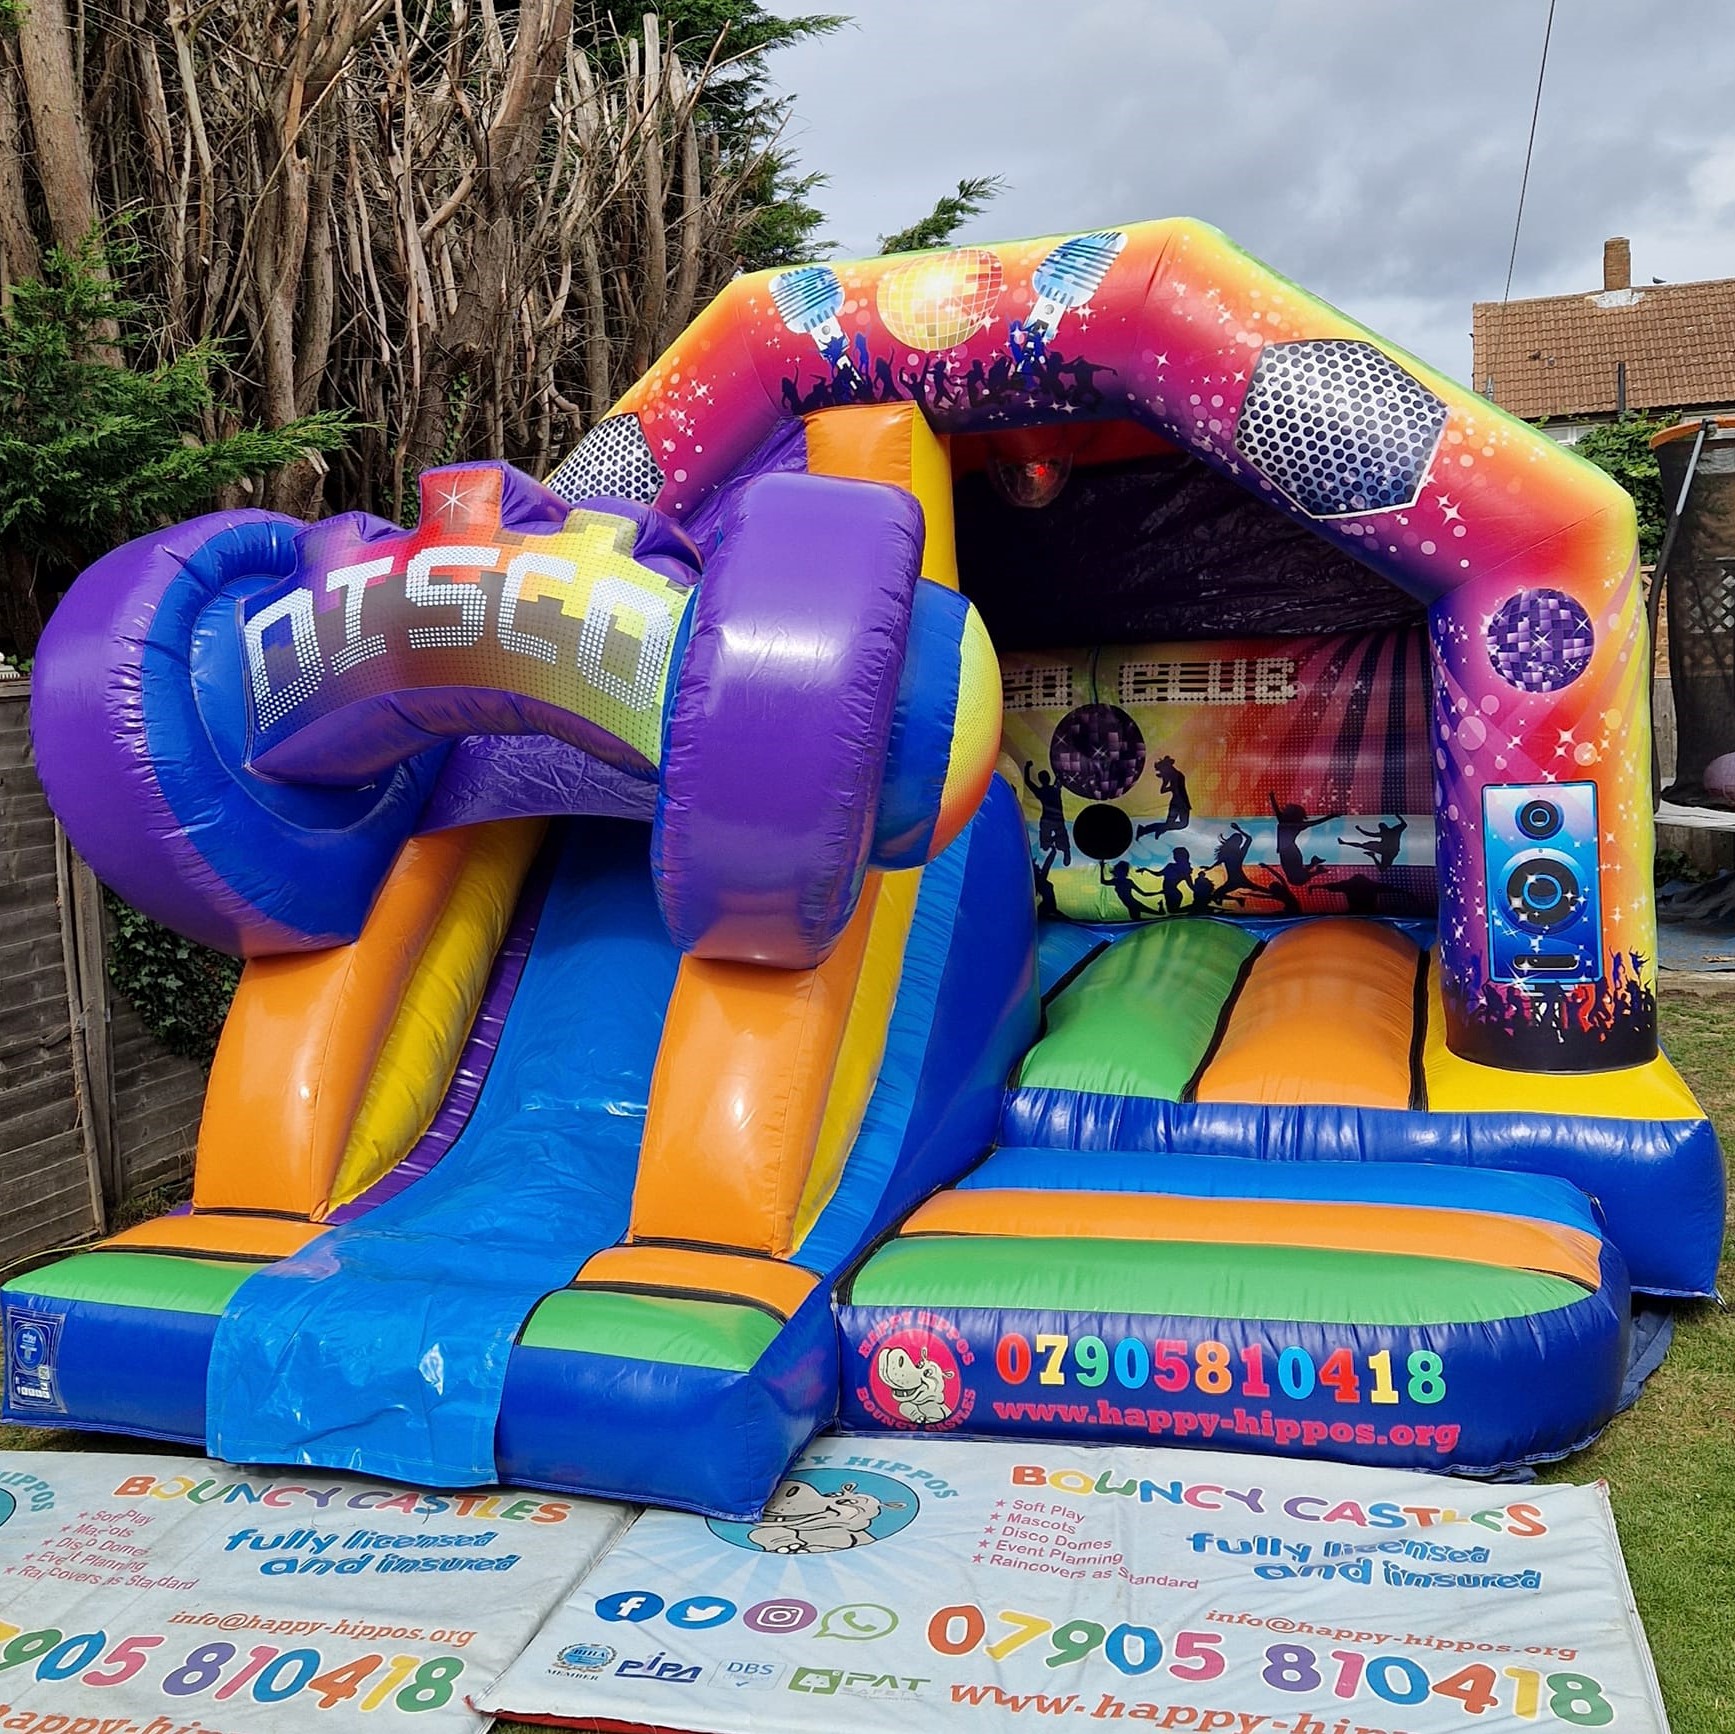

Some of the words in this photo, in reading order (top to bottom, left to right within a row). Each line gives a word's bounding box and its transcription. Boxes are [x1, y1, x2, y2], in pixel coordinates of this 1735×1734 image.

[243, 545, 673, 732] DISCO
[1119, 656, 1297, 705] CLUB
[858, 1311, 913, 1359] HAPPY
[996, 1332, 1447, 1405] 07905810418
[993, 1399, 1462, 1453] www.happy-hippos.org
[844, 1455, 960, 1499] HIPPOS
[1010, 1464, 1265, 1514] BOUNCY
[113, 1475, 343, 1509] BOUNCY
[346, 1490, 571, 1524] CASTLES
[1012, 1499, 1046, 1513] Soft
[1050, 1504, 1086, 1524] Play
[224, 1528, 340, 1556] fully
[342, 1528, 499, 1550] licensed
[1001, 1525, 1050, 1544] Disco
[1054, 1535, 1113, 1551] Domes
[1006, 1512, 1077, 1535] Mascots
[55, 1537, 98, 1550] Diso
[995, 1540, 1045, 1558] Event
[1049, 1550, 1124, 1567] Planning
[1186, 1532, 1313, 1562] fully
[1322, 1538, 1492, 1565] licensed
[259, 1554, 375, 1577] and
[376, 1552, 522, 1574] insured
[989, 1553, 1087, 1580] Raincovers
[1091, 1569, 1113, 1580] as
[1117, 1566, 1200, 1590] Standard
[1252, 1556, 1374, 1587] and
[1382, 1559, 1544, 1590] insured
[167, 1610, 478, 1648] info@happy-hippos.org
[1205, 1609, 1579, 1661] info@happy-hippos.org
[0, 1617, 167, 1688] 905
[161, 1640, 467, 1713] 810418
[545, 1668, 599, 1681] MEMBER
[727, 1662, 775, 1675] DBS
[845, 1672, 931, 1692] PAT
[926, 1603, 1227, 1682] 07905
[1261, 1642, 1615, 1727] 810418
